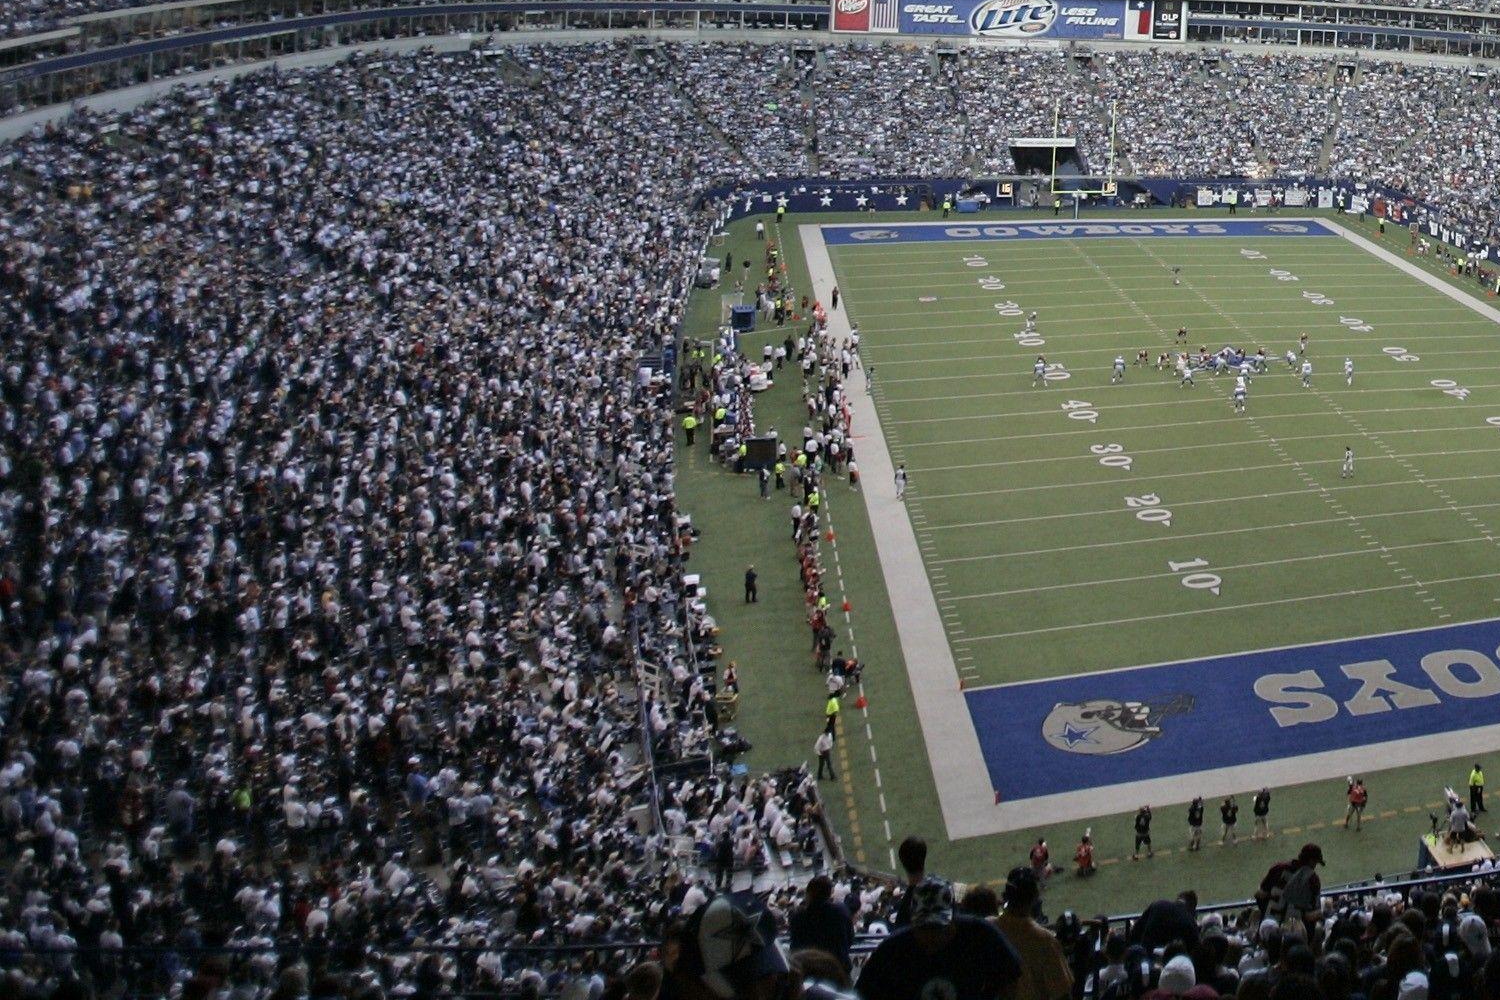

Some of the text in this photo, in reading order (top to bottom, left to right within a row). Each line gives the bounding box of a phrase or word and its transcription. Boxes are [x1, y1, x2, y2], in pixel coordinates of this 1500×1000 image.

[904, 4, 953, 14] GREAT
[1060, 7, 1098, 16] LESS
[979, 2, 1053, 32] Lite
[1066, 17, 1120, 26] FILLING
[1161, 13, 1179, 21] DLP
[945, 223, 1227, 237] COWBOYS
[994, 301, 1024, 316] 30
[1340, 316, 1374, 332] 40
[1382, 347, 1420, 361] 50
[1430, 379, 1471, 399] 40
[1061, 400, 1099, 422] 40
[1090, 443, 1133, 467] 30
[1124, 493, 1173, 523] 20
[1168, 557, 1222, 589] 10
